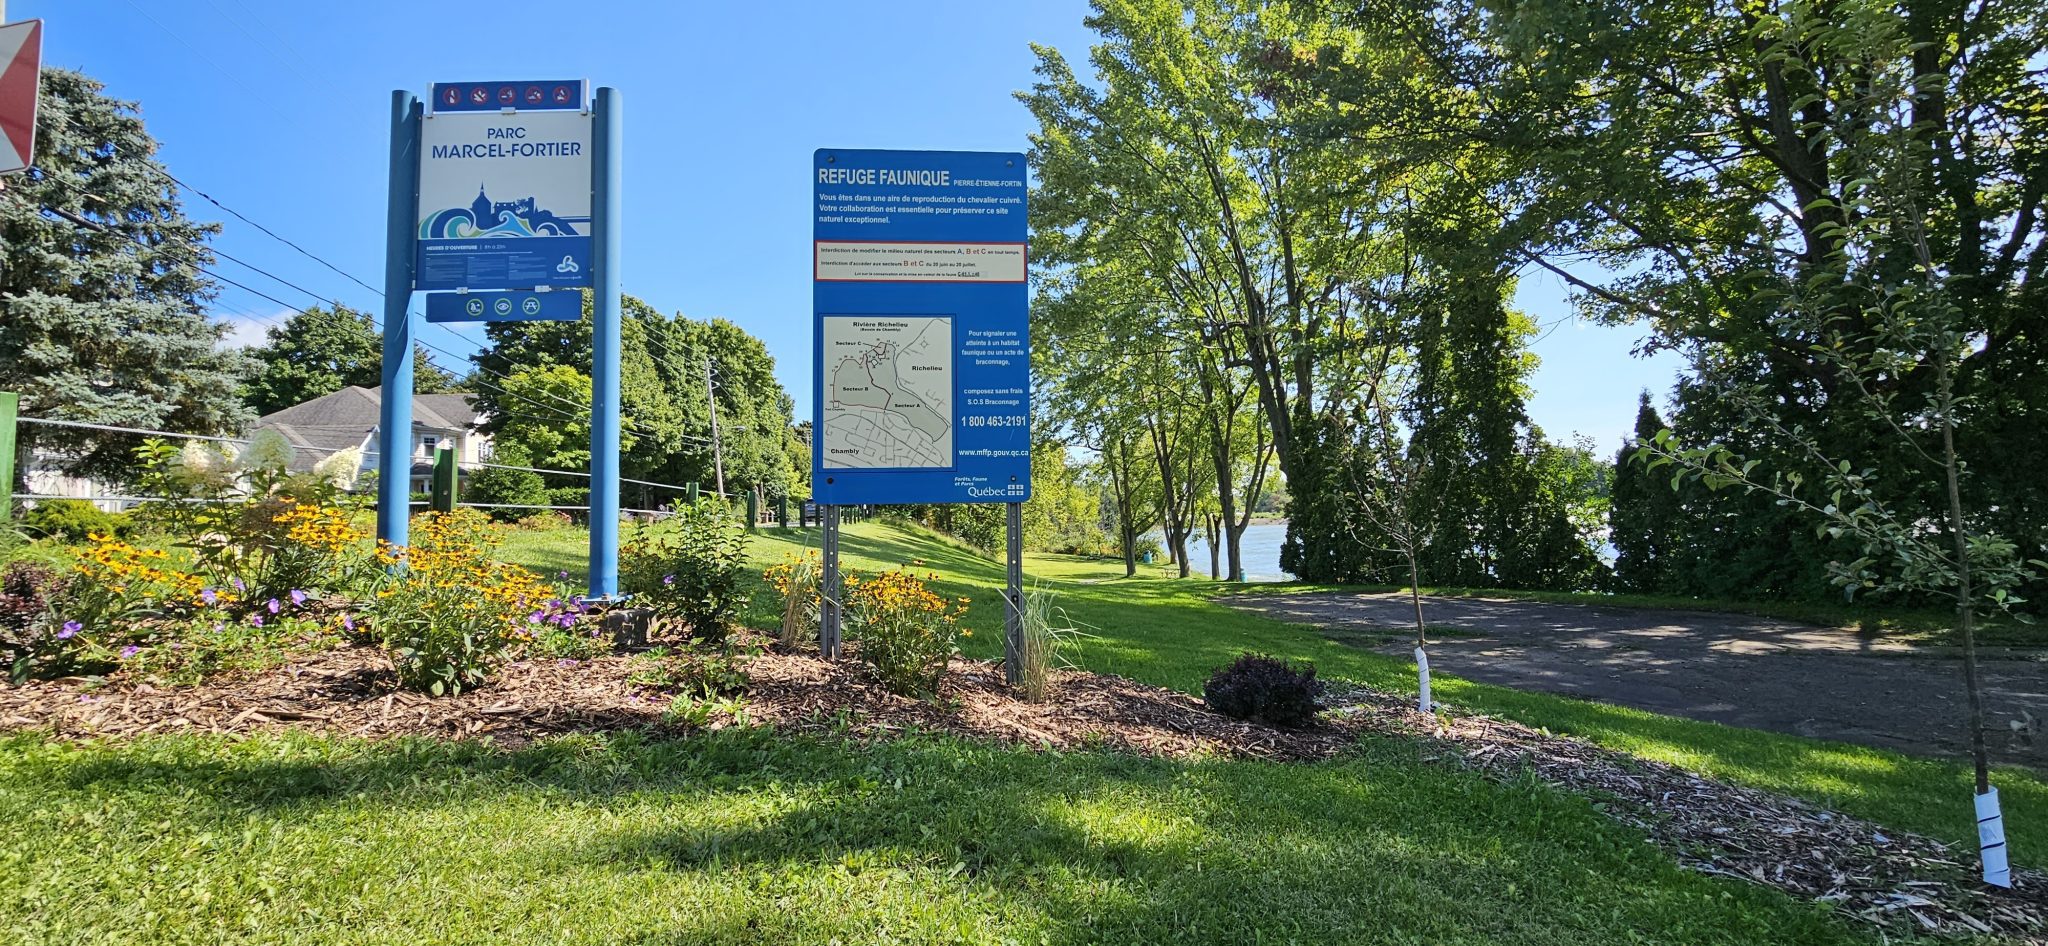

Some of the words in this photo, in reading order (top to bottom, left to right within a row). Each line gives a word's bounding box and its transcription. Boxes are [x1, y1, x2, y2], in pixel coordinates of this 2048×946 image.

[487, 127, 526, 139] PARC
[432, 142, 581, 158] MARCEL-FORTIER
[818, 168, 876, 184] REFUGE
[880, 170, 950, 187] FAUNIQUE
[912, 196, 955, 204] reproduction
[839, 204, 884, 212] collaboration
[897, 206, 934, 214] essentielle
[953, 206, 985, 215] préserver
[844, 216, 890, 224] exceptionnel.
[961, 416, 966, 426] 1
[969, 416, 984, 427] 800
[987, 416, 1026, 427] 463-2191
[959, 449, 1028, 457] www.mffp.gouv.qc.ca
[968, 486, 1006, 498] Québec
